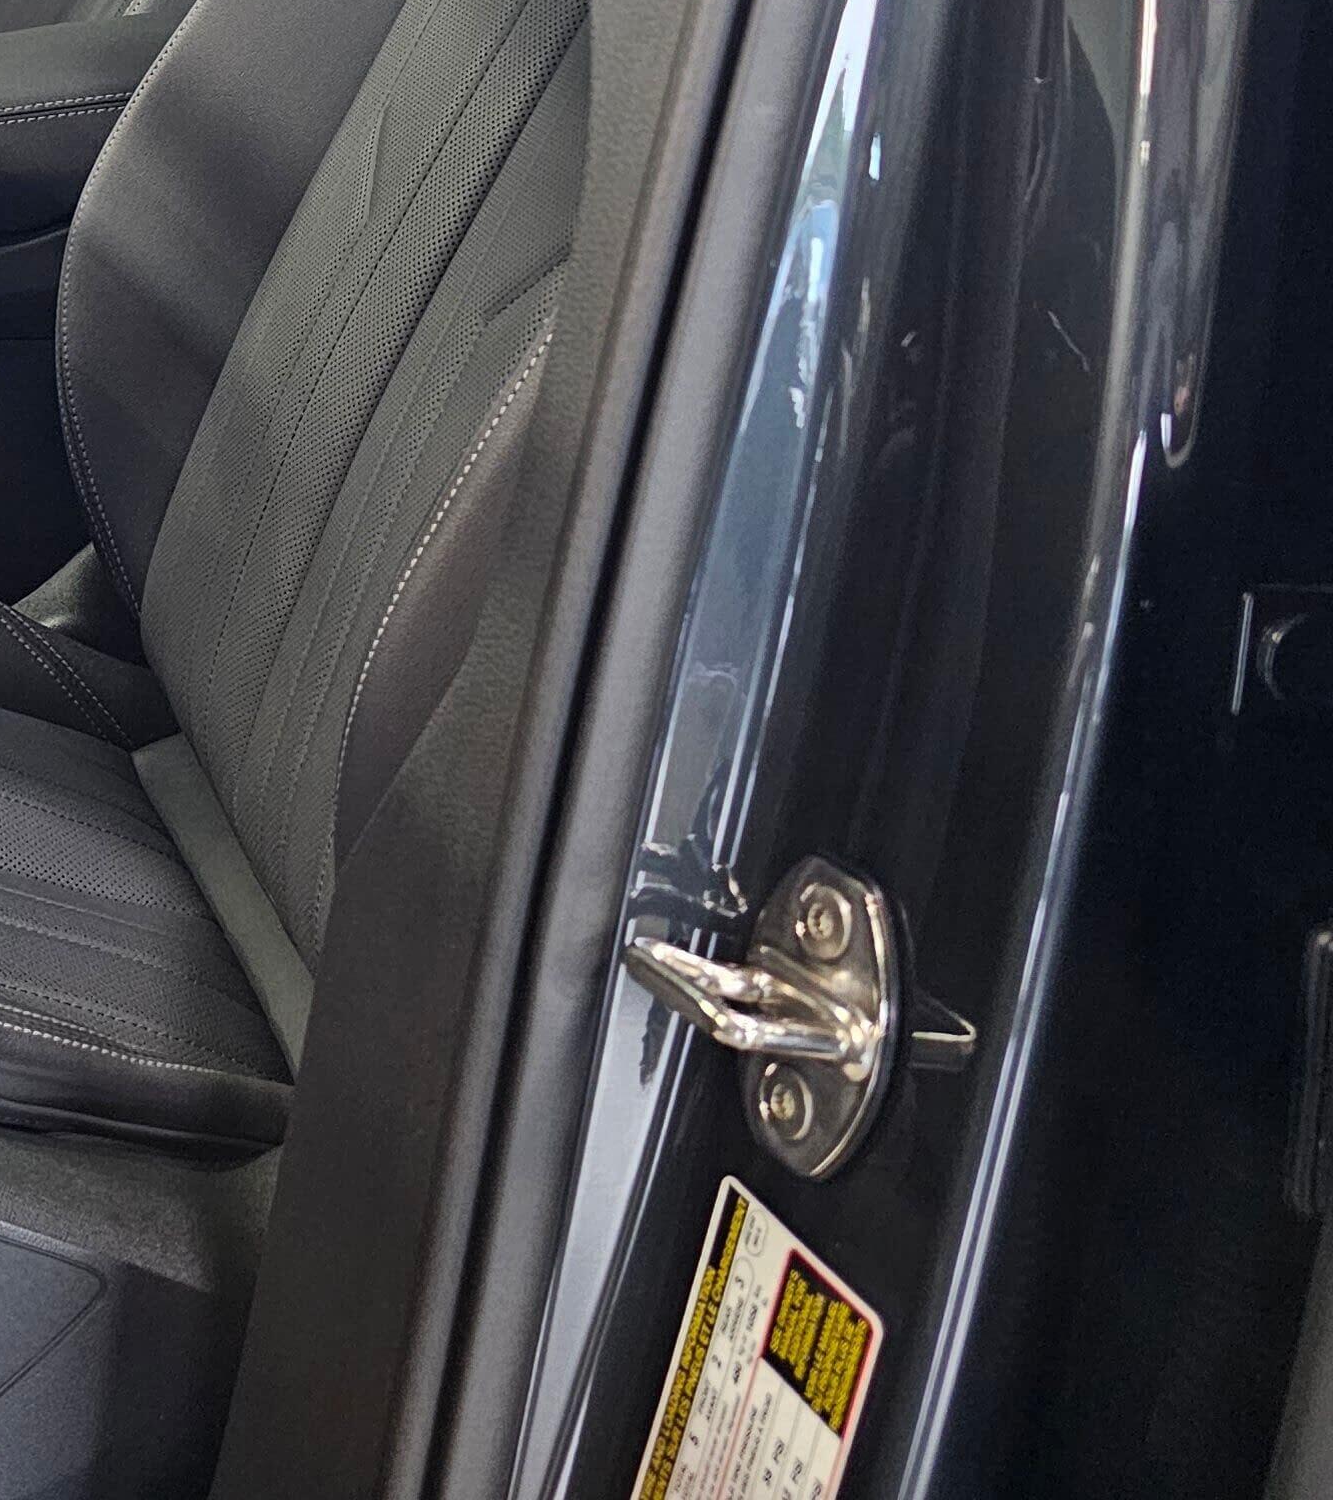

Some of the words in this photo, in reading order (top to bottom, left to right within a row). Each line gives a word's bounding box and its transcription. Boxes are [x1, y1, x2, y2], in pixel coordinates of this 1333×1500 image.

[665, 1423, 681, 1460] SUR
[675, 1394, 690, 1427] LES
[683, 1342, 705, 1398] PNEUS
[710, 1196, 748, 1303] CHARGEMENT
[767, 1324, 782, 1354] SEE
[776, 1305, 799, 1362] MANUAL
[791, 1276, 808, 1309] FOR
[786, 1289, 814, 1365] ADDITIONAL
[792, 1290, 826, 1382] INFORMATION
[650, 1434, 666, 1471] AND
[660, 1367, 686, 1437] LOADING
[679, 1264, 717, 1369] INFORMATION
[687, 1429, 699, 1448] 5
